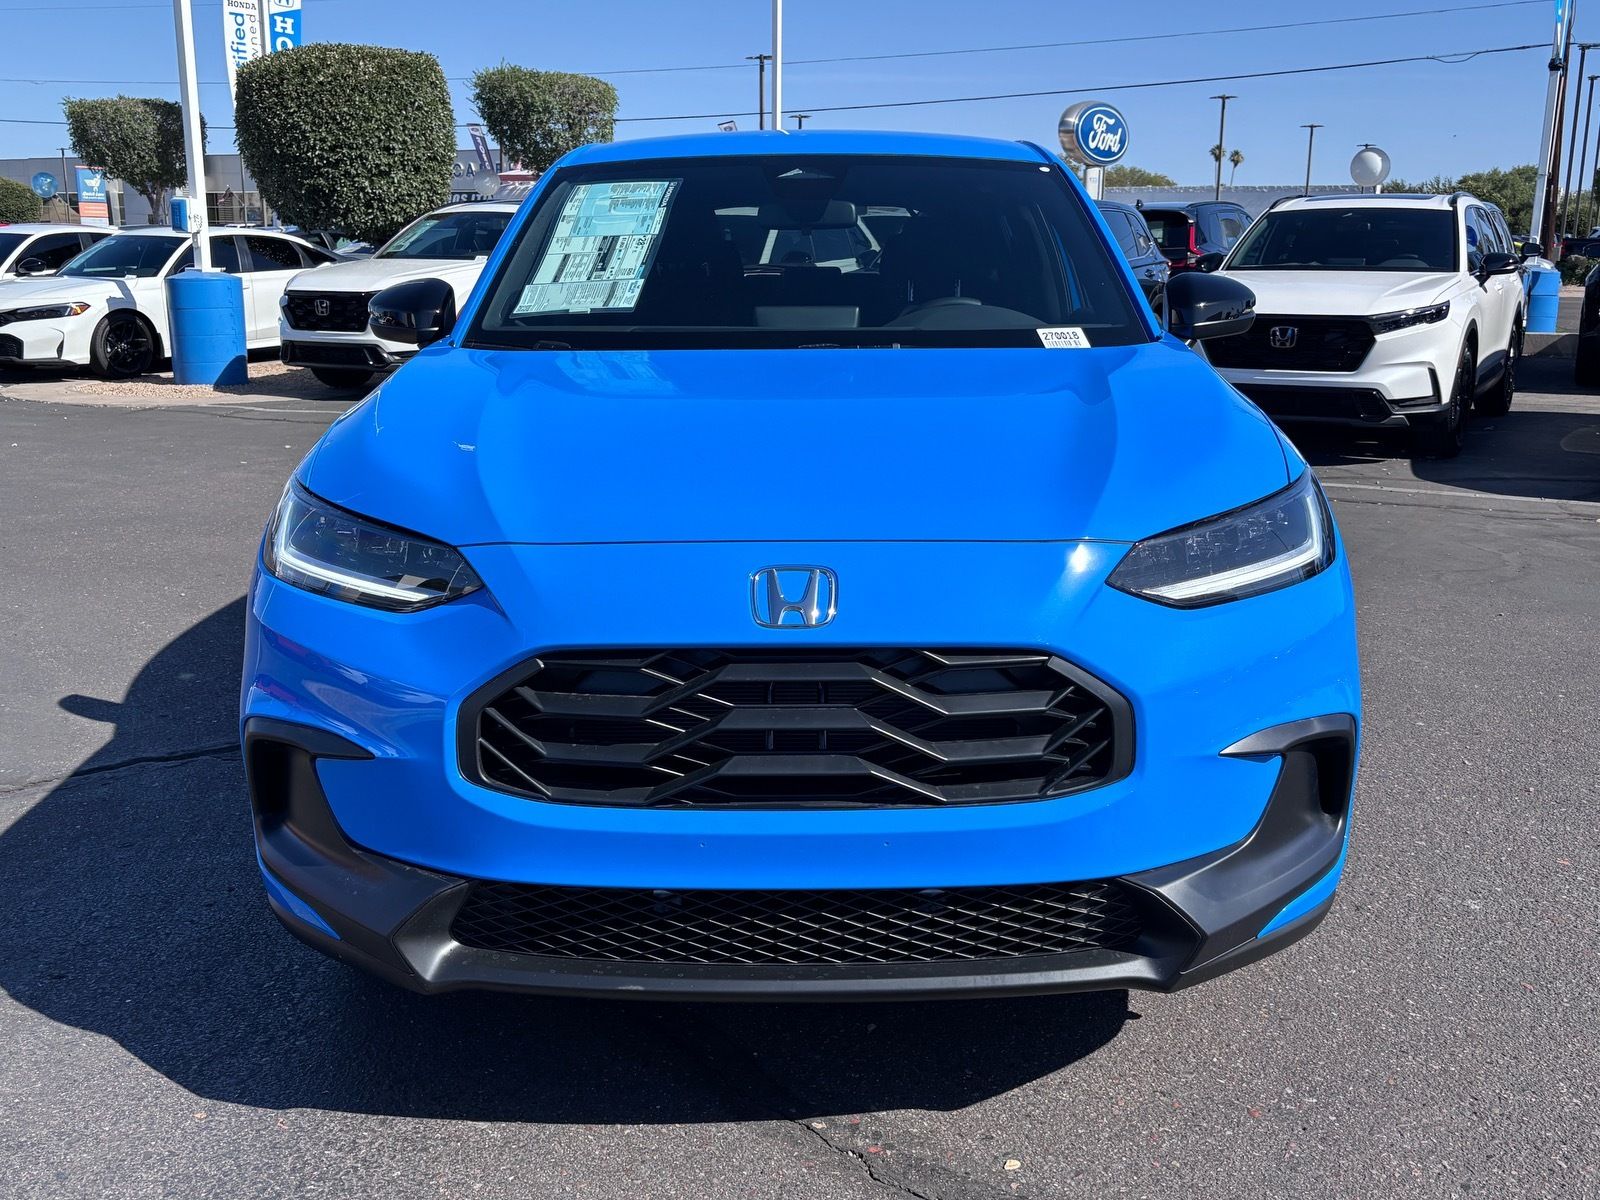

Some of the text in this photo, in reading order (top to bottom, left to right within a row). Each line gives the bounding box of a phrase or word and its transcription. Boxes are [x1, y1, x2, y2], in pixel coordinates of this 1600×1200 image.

[227, 0, 257, 10] HONDA
[1088, 113, 1122, 153] Ford
[661, 186, 675, 208] HONDA
[1042, 331, 1080, 341] 270018
